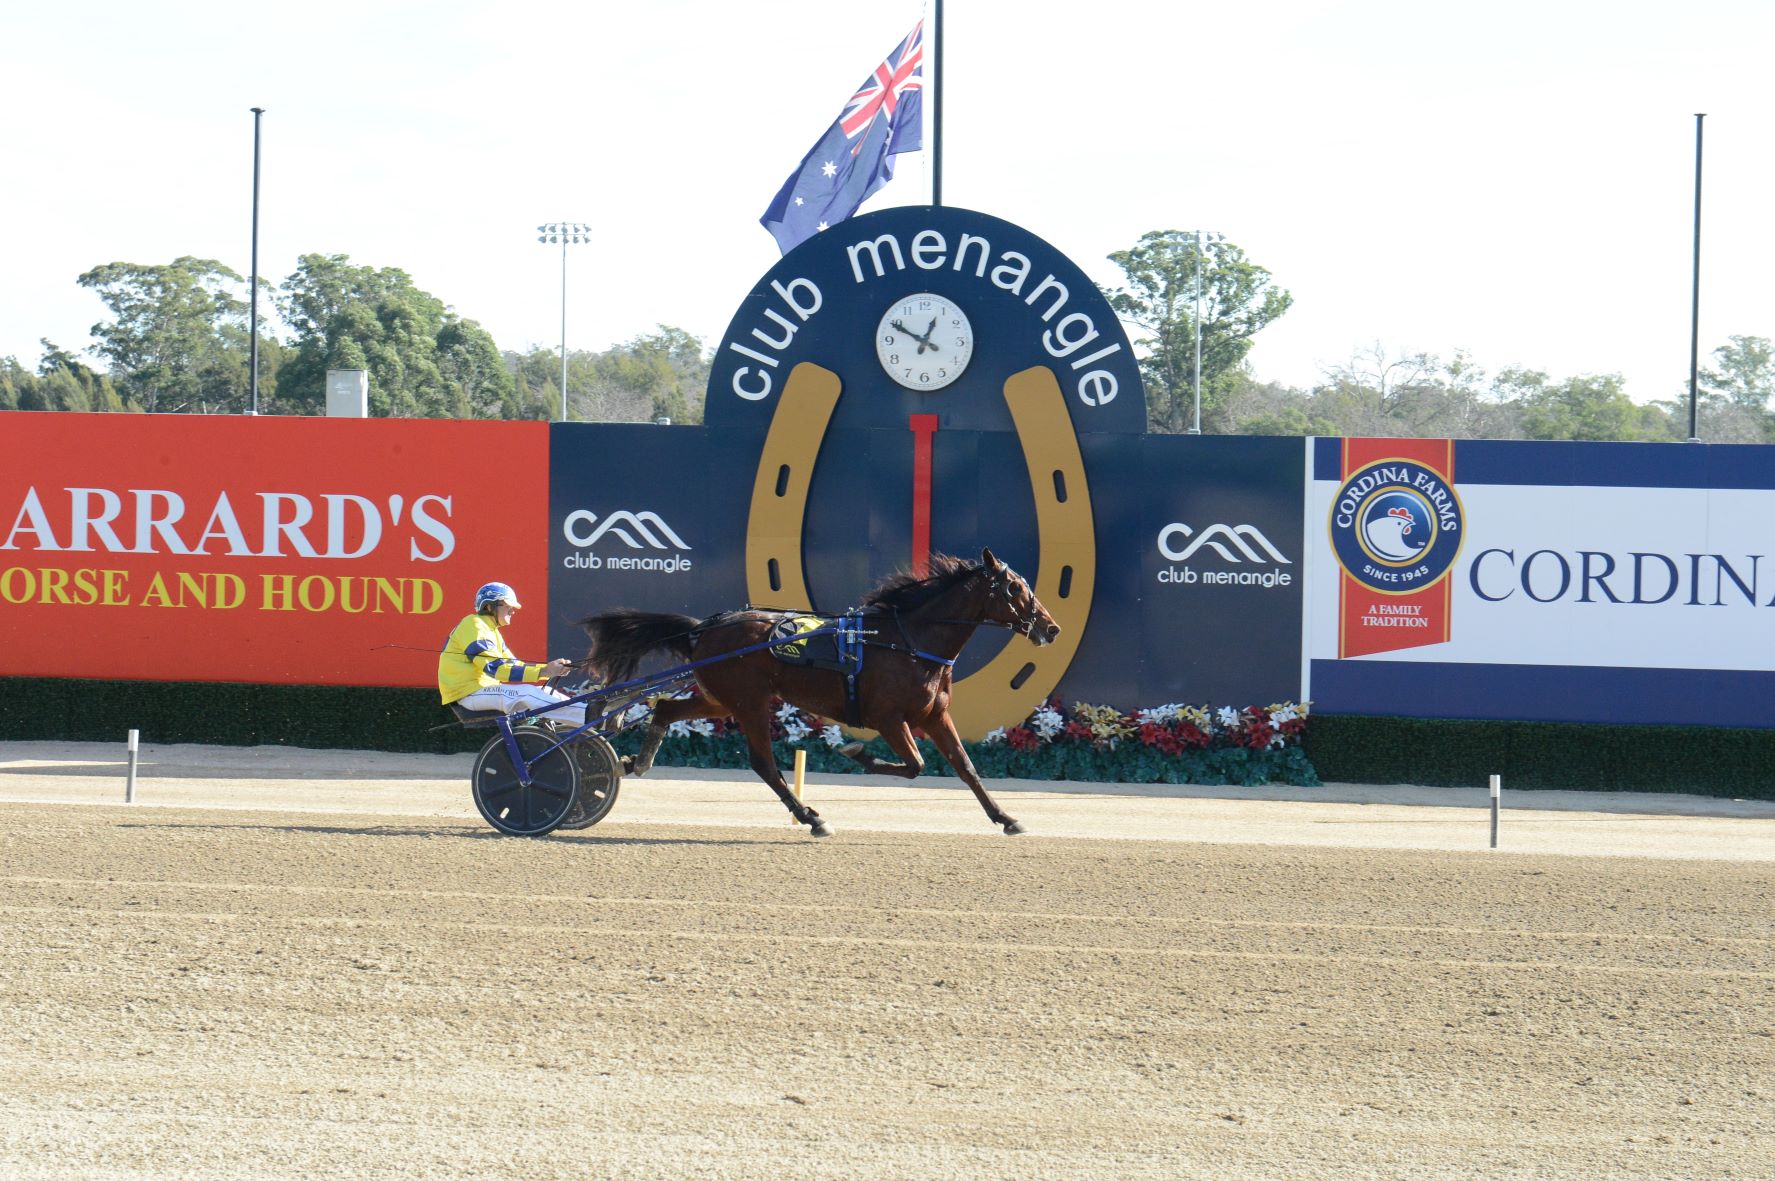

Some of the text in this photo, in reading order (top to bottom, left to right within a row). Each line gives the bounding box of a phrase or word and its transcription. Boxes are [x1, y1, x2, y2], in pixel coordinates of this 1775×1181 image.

[903, 306, 912, 316] 11
[919, 301, 931, 311] 12
[730, 229, 1121, 407] club menangle
[952, 319, 961, 329] 2
[884, 335, 894, 346] 9
[955, 336, 965, 347] 3
[889, 353, 900, 365] 8
[904, 368, 912, 378] 7
[920, 372, 930, 383] 6
[938, 367, 947, 378] 5
[1337, 467, 1457, 531] CORDINA FARMS
[0, 485, 456, 562] ARRARD'S
[563, 551, 692, 574] club menangle
[1157, 566, 1292, 588] club menangle
[1363, 564, 1430, 583] SINCE 1945
[1469, 548, 1775, 608] CORDIN
[0, 566, 444, 615] ORSE AND HOUND
[1368, 605, 1422, 616] A FAMILY
[1361, 616, 1429, 628] TRADITION
